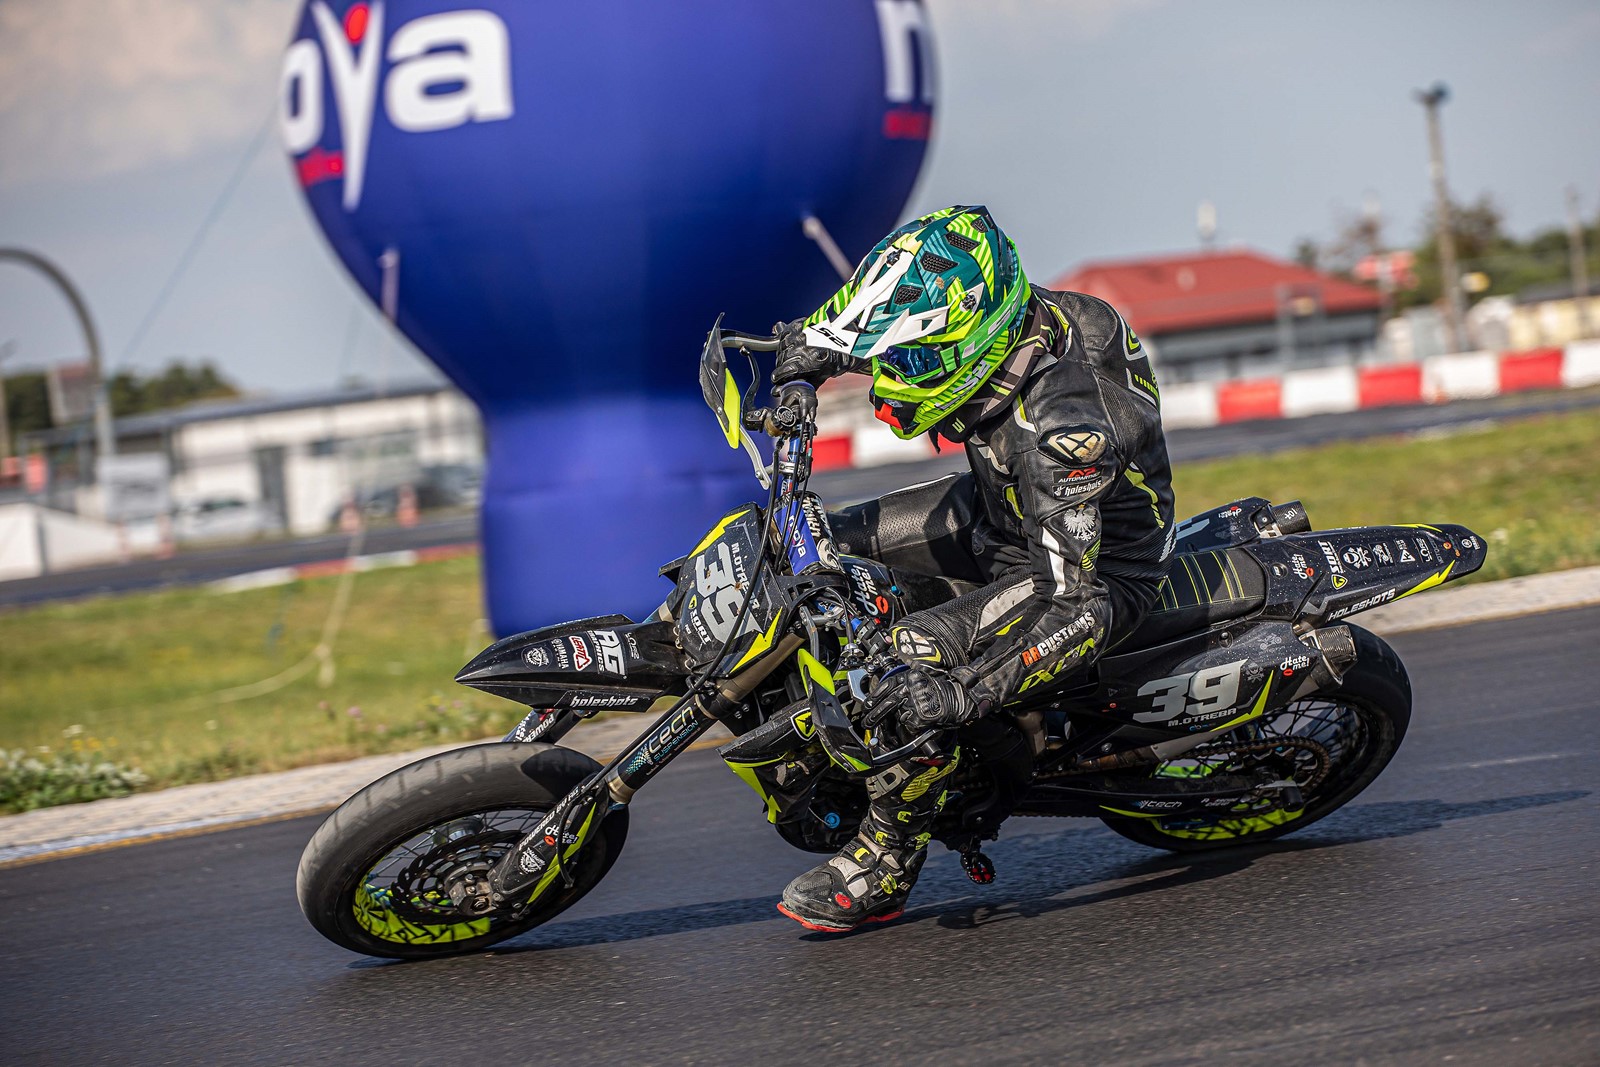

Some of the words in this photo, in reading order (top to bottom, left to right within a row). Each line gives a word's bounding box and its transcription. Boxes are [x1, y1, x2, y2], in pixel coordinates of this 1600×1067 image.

[807, 322, 849, 348] LS2
[934, 360, 991, 410] LS2
[1318, 540, 1341, 574] SORT
[695, 542, 763, 644] 39
[731, 542, 760, 609] M.OTREA
[851, 568, 879, 616] Hate
[852, 565, 878, 595] me!
[1328, 588, 1396, 621] HOLESHOTS
[557, 642, 569, 669] YAMAHA
[587, 630, 604, 672] GRAPHICS
[1280, 655, 1307, 670] Hate
[1293, 658, 1310, 670] me!
[570, 696, 638, 707] holeshots
[1133, 659, 1249, 723] 39
[1168, 707, 1237, 727] M.OTREBA
[653, 719, 699, 762] SUSPENSION
[865, 763, 910, 800] SIDI
[519, 808, 556, 851] POWERED
